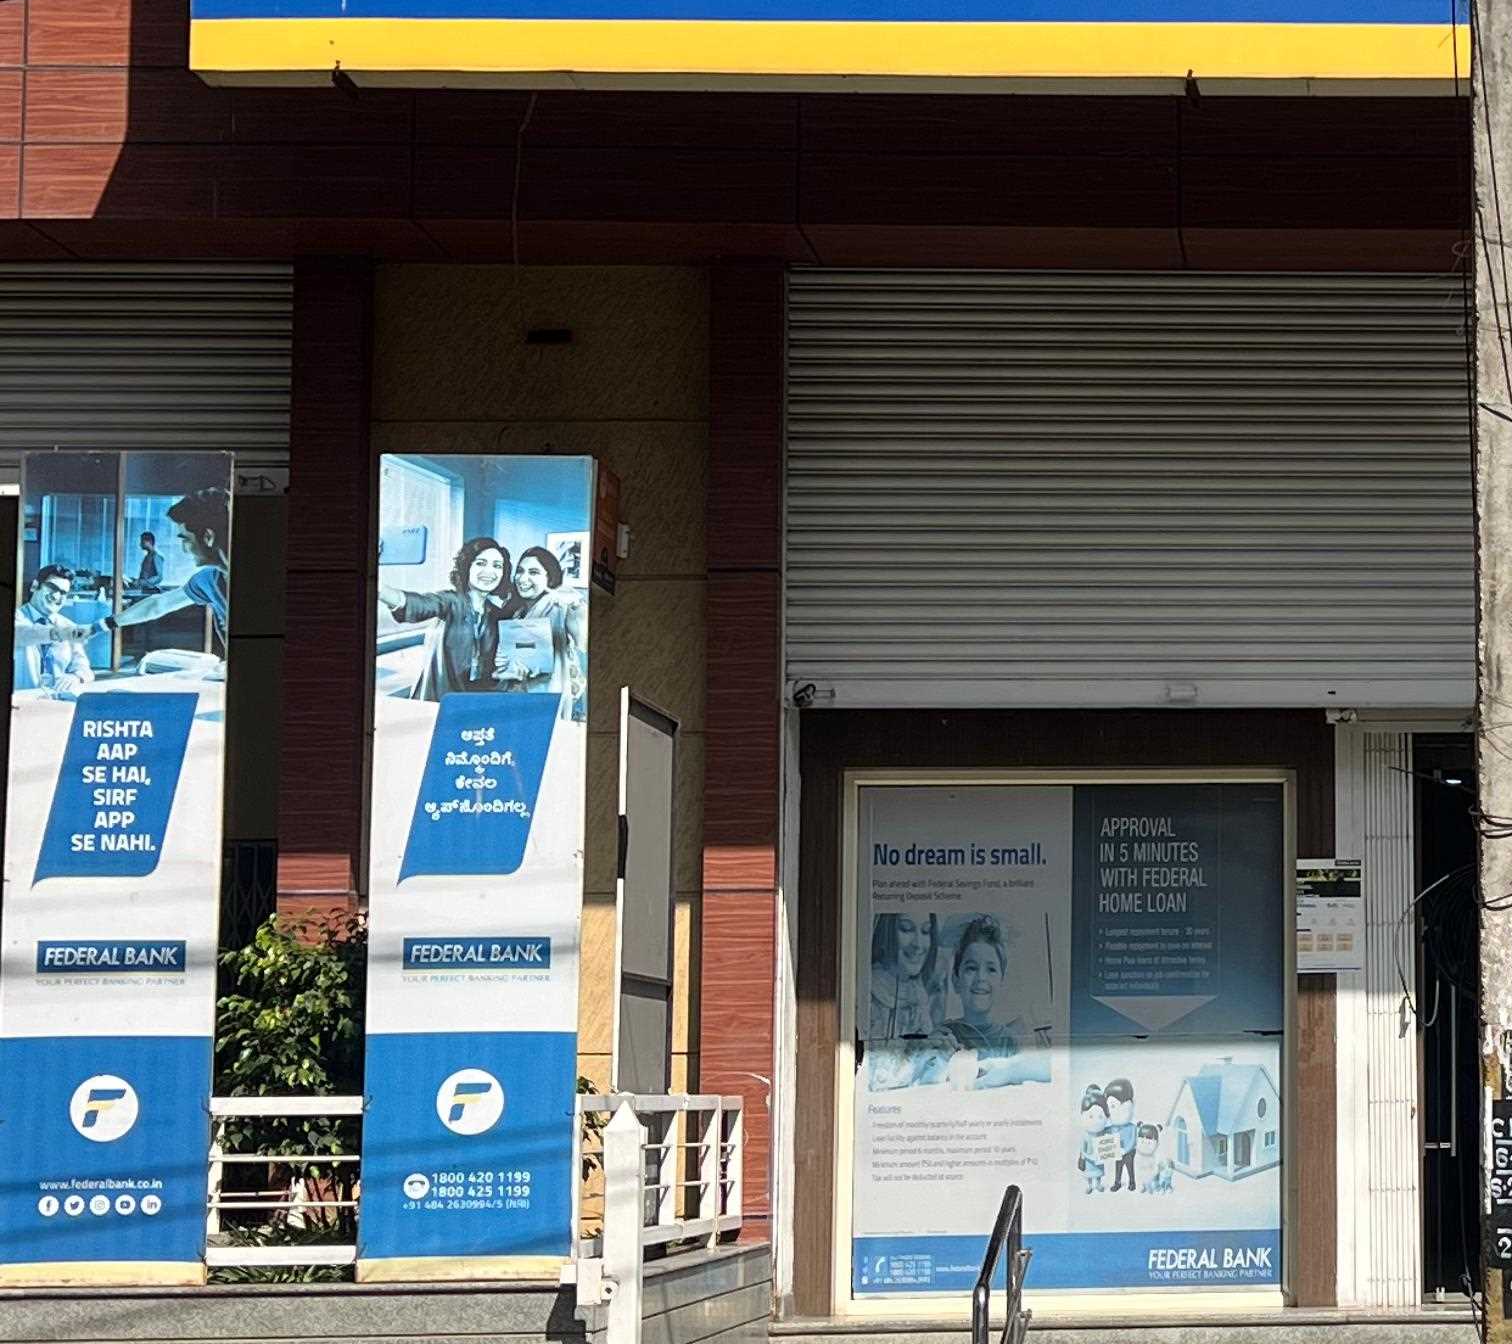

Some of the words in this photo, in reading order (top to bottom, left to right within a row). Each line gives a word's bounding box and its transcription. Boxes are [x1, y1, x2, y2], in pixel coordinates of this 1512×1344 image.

[83, 719, 153, 738] RISHTA
[96, 742, 138, 761] AAP
[82, 765, 107, 784] SE
[111, 765, 152, 786] HAI,
[93, 788, 138, 806] SIRF
[94, 810, 136, 829] APP
[1100, 816, 1177, 838] APPROVAL
[71, 833, 96, 852] SE
[100, 833, 156, 852] NAHI.
[1099, 842, 1115, 863] IN
[1119, 842, 1129, 863] 5
[1133, 841, 1200, 863] MINUTES
[872, 842, 900, 866] No
[904, 842, 966, 866] dream
[970, 842, 986, 866] is
[990, 842, 1047, 866] small.
[1100, 867, 1138, 888] WITH
[1142, 867, 1208, 888] FEDERAL
[1099, 892, 1143, 914] HOME
[1147, 892, 1187, 913] LOAN
[43, 946, 121, 966] FEDERAL
[123, 946, 179, 966] BANK
[410, 943, 487, 964] FEDERAL
[489, 943, 544, 963] BANK
[430, 1171, 465, 1184] 1800
[497, 1171, 532, 1184] 1199
[430, 1185, 465, 1198] 1800
[467, 1185, 493, 1198] 425
[497, 1185, 531, 1198] 1199
[1147, 1248, 1218, 1270] FEDERAL
[1222, 1247, 1272, 1269] BANK
